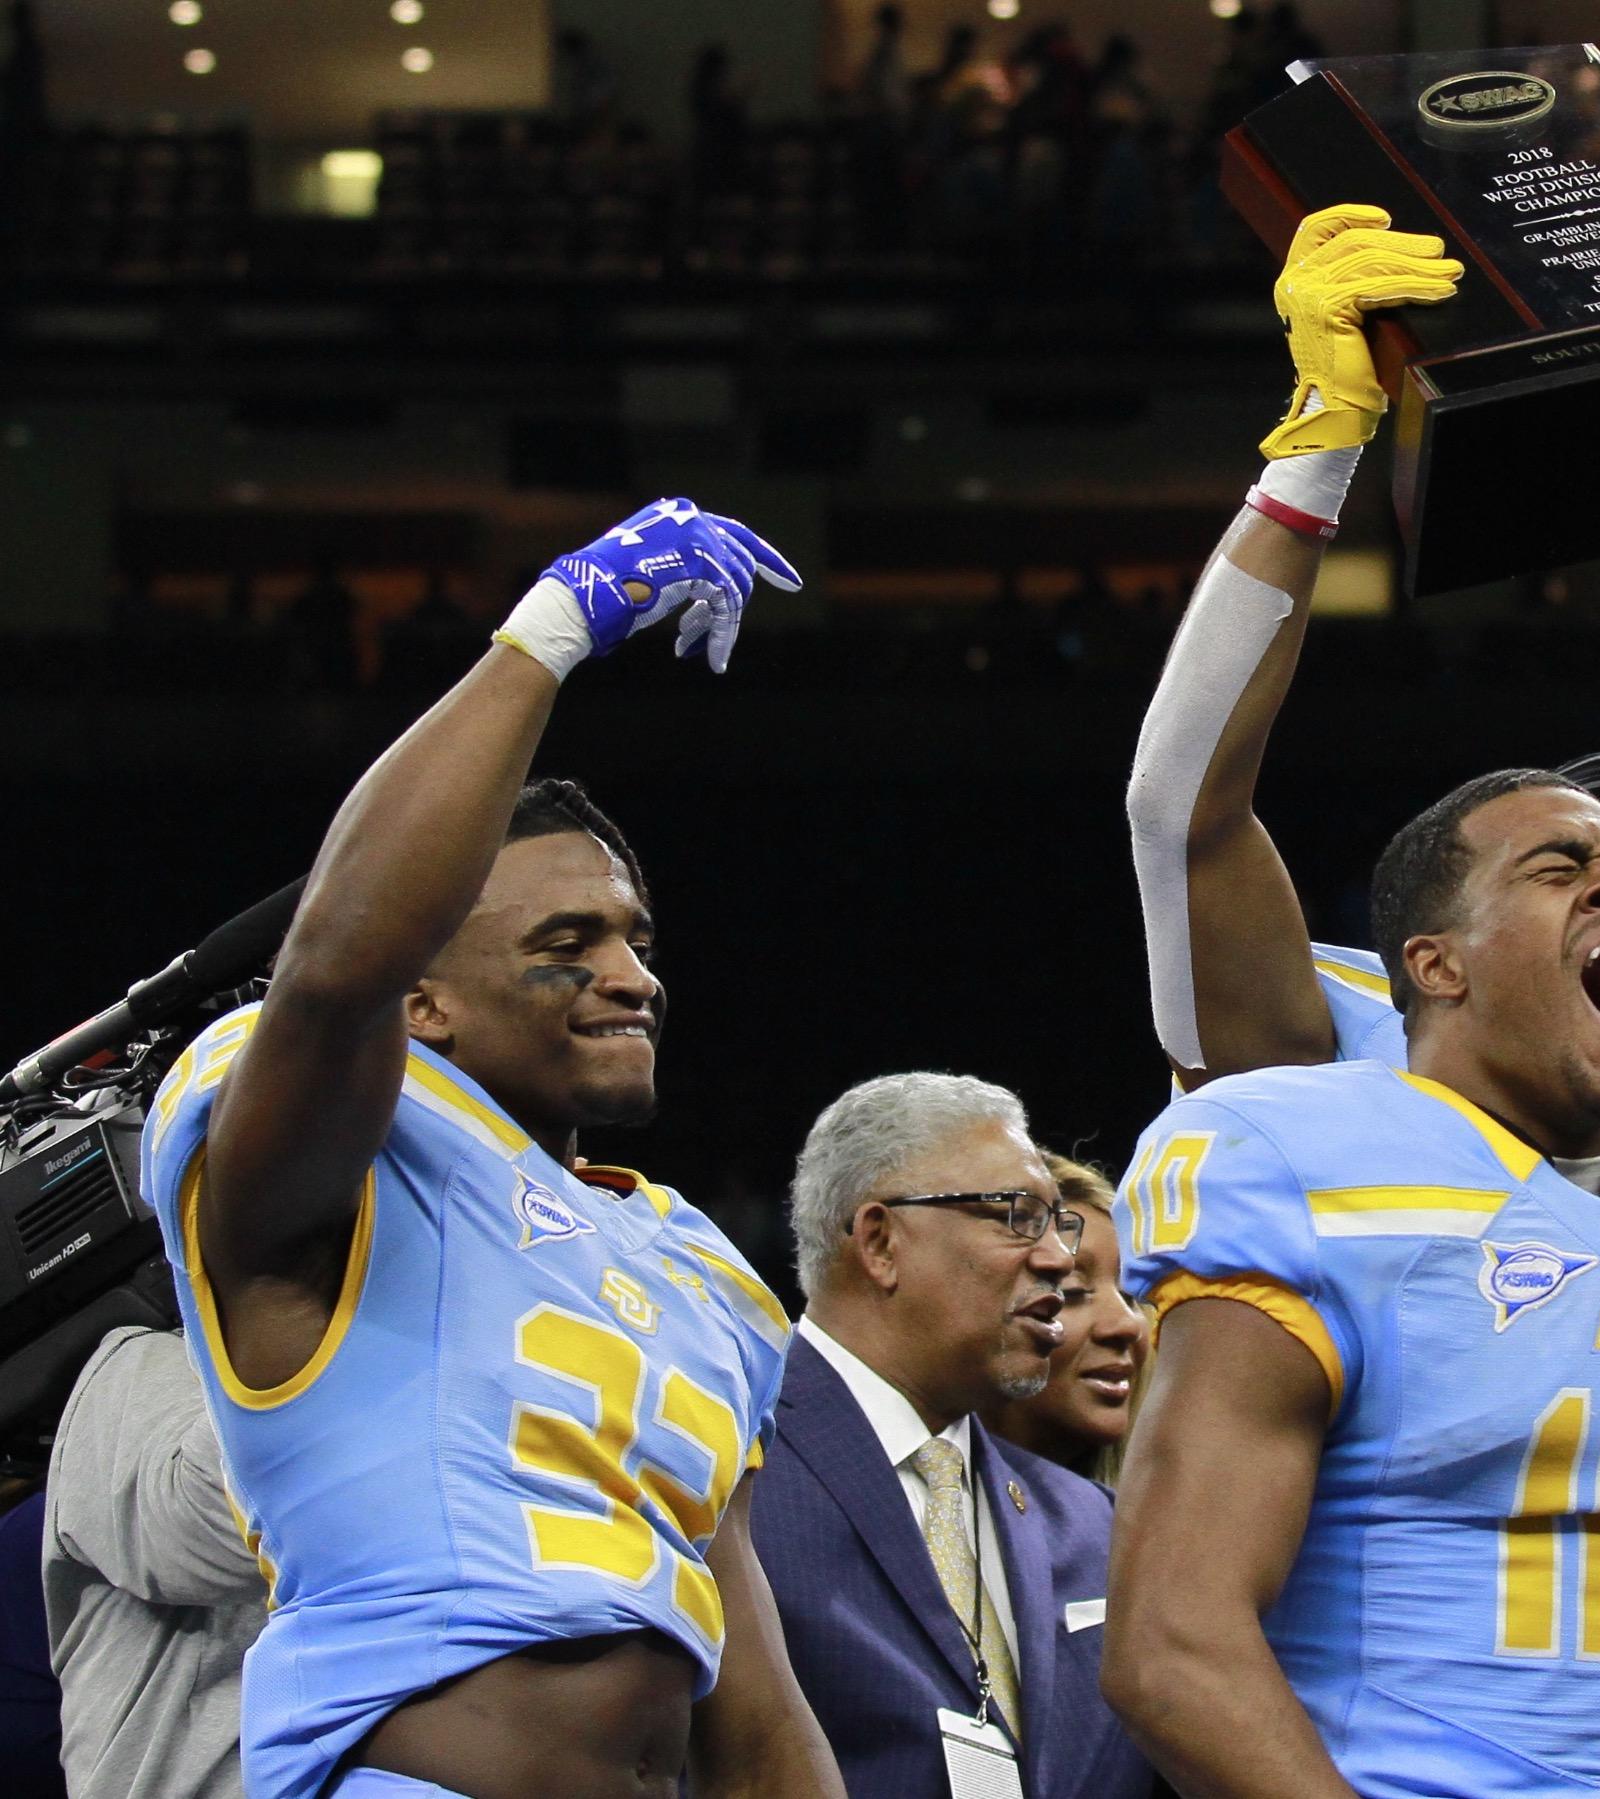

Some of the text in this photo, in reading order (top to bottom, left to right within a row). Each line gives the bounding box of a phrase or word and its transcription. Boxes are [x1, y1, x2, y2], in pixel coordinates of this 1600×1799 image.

[1508, 146, 1553, 165] 2018
[1492, 159, 1597, 187] FOOTBALL
[1482, 184, 1536, 204] WEST
[1541, 249, 1600, 268] PRAIRIE
[44, 1135, 92, 1175] Ikegami
[1124, 1130, 1218, 1259] 10
[29, 1243, 76, 1280] Unicam HD
[602, 1268, 658, 1333] SU
